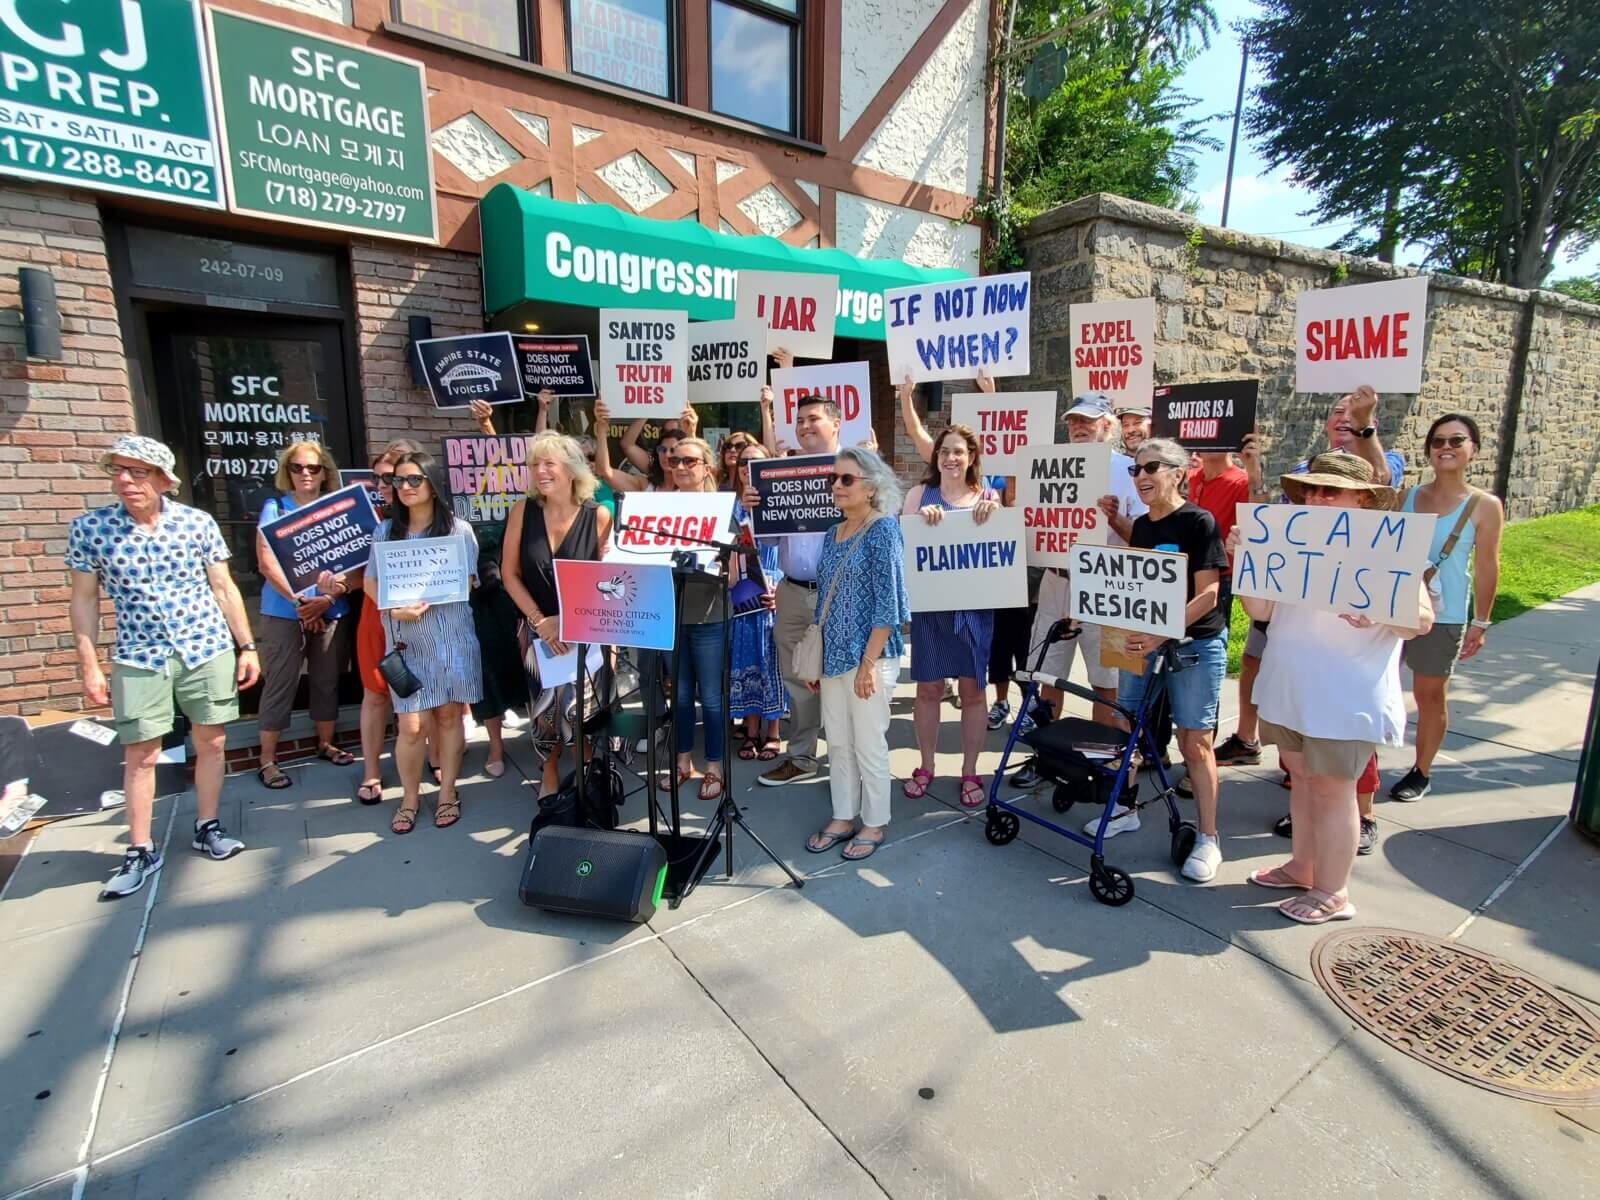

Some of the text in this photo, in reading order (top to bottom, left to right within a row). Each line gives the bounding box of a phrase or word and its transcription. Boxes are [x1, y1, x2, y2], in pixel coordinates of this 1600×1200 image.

[613, 36, 665, 74] ESTATE
[291, 47, 361, 90] SFC
[0, 52, 171, 123] PREP.
[249, 75, 405, 138] MORTGAGE
[257, 120, 331, 156] LOAN
[163, 140, 206, 161] ACT
[61, 147, 211, 194] 288-8402
[240, 150, 424, 201] SFCMortgage@yahoo.com
[265, 180, 406, 224] (718) 279-2797
[200, 258, 284, 282] 242-07-09
[836, 289, 883, 325] rge
[889, 281, 1029, 328] IF NOT NOW
[608, 321, 675, 341] SANTOS
[1081, 320, 1135, 345] EXPEL
[1306, 312, 1410, 362] SHAME
[527, 353, 570, 364] DOES NOT
[626, 343, 662, 361] LIES
[691, 341, 749, 361] SANTOS
[916, 327, 1018, 371] WHEN?
[1075, 344, 1143, 368] SANTOS
[434, 350, 502, 374] EMPIRE STATE
[525, 364, 577, 375] STAND WITH
[714, 362, 733, 380] TO
[737, 361, 758, 379] GO
[540, 375, 585, 385] YORKERS
[615, 364, 672, 383] TRUTH
[1088, 370, 1129, 391] NOW
[231, 375, 280, 397] SFC
[452, 384, 491, 395] VOICES
[624, 386, 664, 404] DIES
[204, 403, 311, 424] MORTGAGE
[783, 384, 860, 424] FUD
[1168, 399, 1234, 420] SANTOS IS A
[977, 410, 1028, 432] TIME
[1180, 420, 1217, 439] FRAUD
[979, 433, 1028, 455] IS UP
[206, 458, 247, 478] (718)
[1031, 457, 1085, 479] MAKE
[772, 478, 827, 493] DOES NOT
[1039, 482, 1078, 504] NY3
[767, 492, 834, 507] STAND WITH
[762, 506, 842, 521] NEW YORKERS
[1024, 507, 1097, 529] SANTOS
[292, 525, 325, 547] DOES
[323, 513, 348, 533] NOT
[622, 515, 718, 547] RESIGN
[1248, 505, 1406, 552] SCAM
[293, 523, 362, 562] STAND WITH
[411, 545, 448, 557] DAYS
[293, 534, 374, 578] NEW YORKERS
[387, 557, 448, 569] WITH NO
[916, 541, 1017, 572] PLAINVIEW
[1079, 551, 1177, 584] SANTOS
[1105, 579, 1144, 592] MUST
[574, 607, 661, 621] CONCERNED CITIZENS
[1079, 590, 1168, 625] RESIGN
[600, 617, 634, 628] OF NY-03
